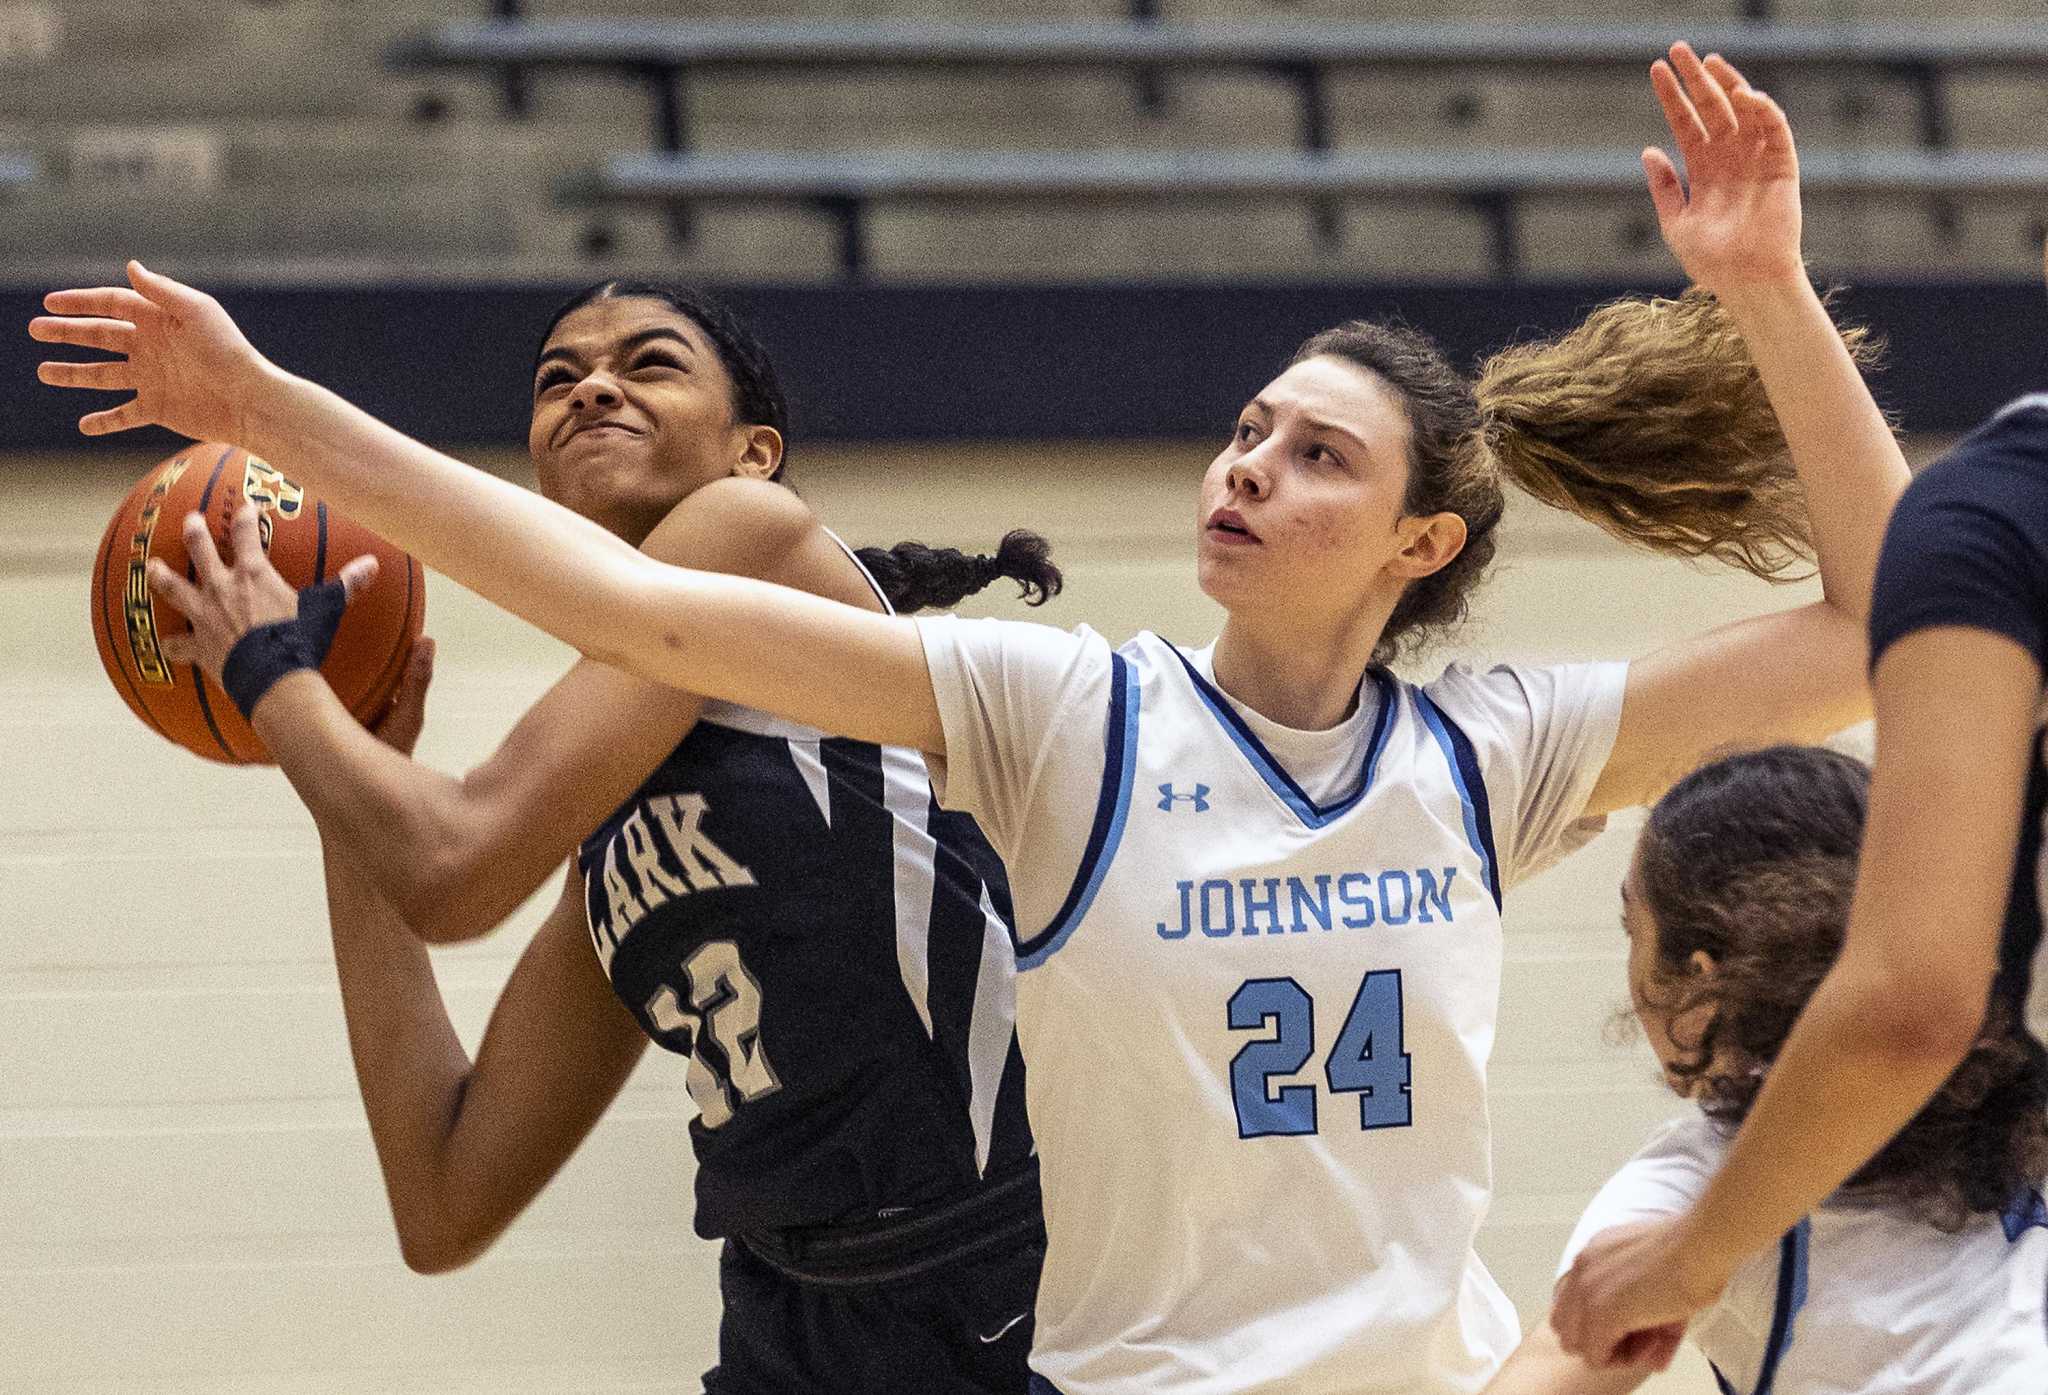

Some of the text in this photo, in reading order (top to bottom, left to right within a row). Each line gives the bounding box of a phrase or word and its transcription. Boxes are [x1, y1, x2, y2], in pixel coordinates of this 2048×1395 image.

[1156, 867, 1457, 940] JOHNSON
[647, 941, 782, 1130] 12
[1226, 968, 1413, 1139] 24
